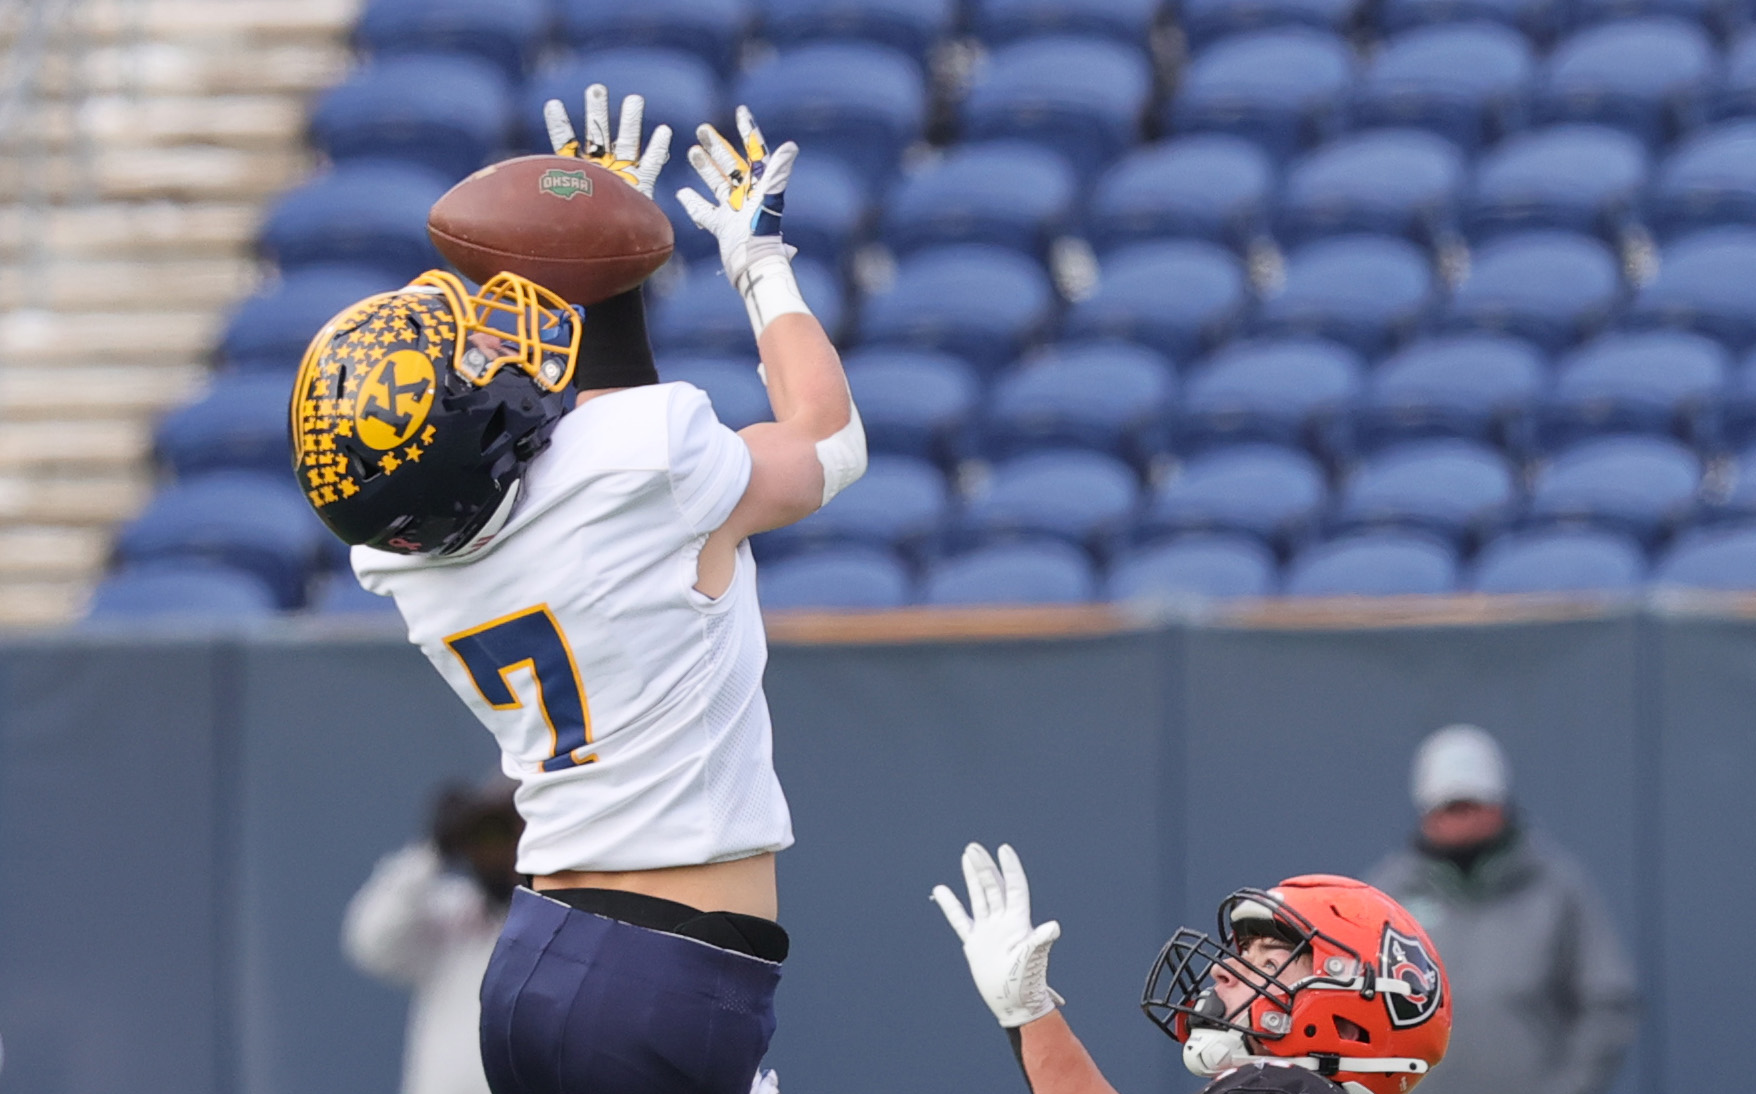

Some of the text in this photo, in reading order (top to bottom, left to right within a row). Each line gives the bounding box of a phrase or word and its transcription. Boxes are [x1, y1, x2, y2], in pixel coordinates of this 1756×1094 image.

[543, 176, 588, 191] OHSAA
[360, 360, 431, 438] K
[441, 602, 599, 773] 7
